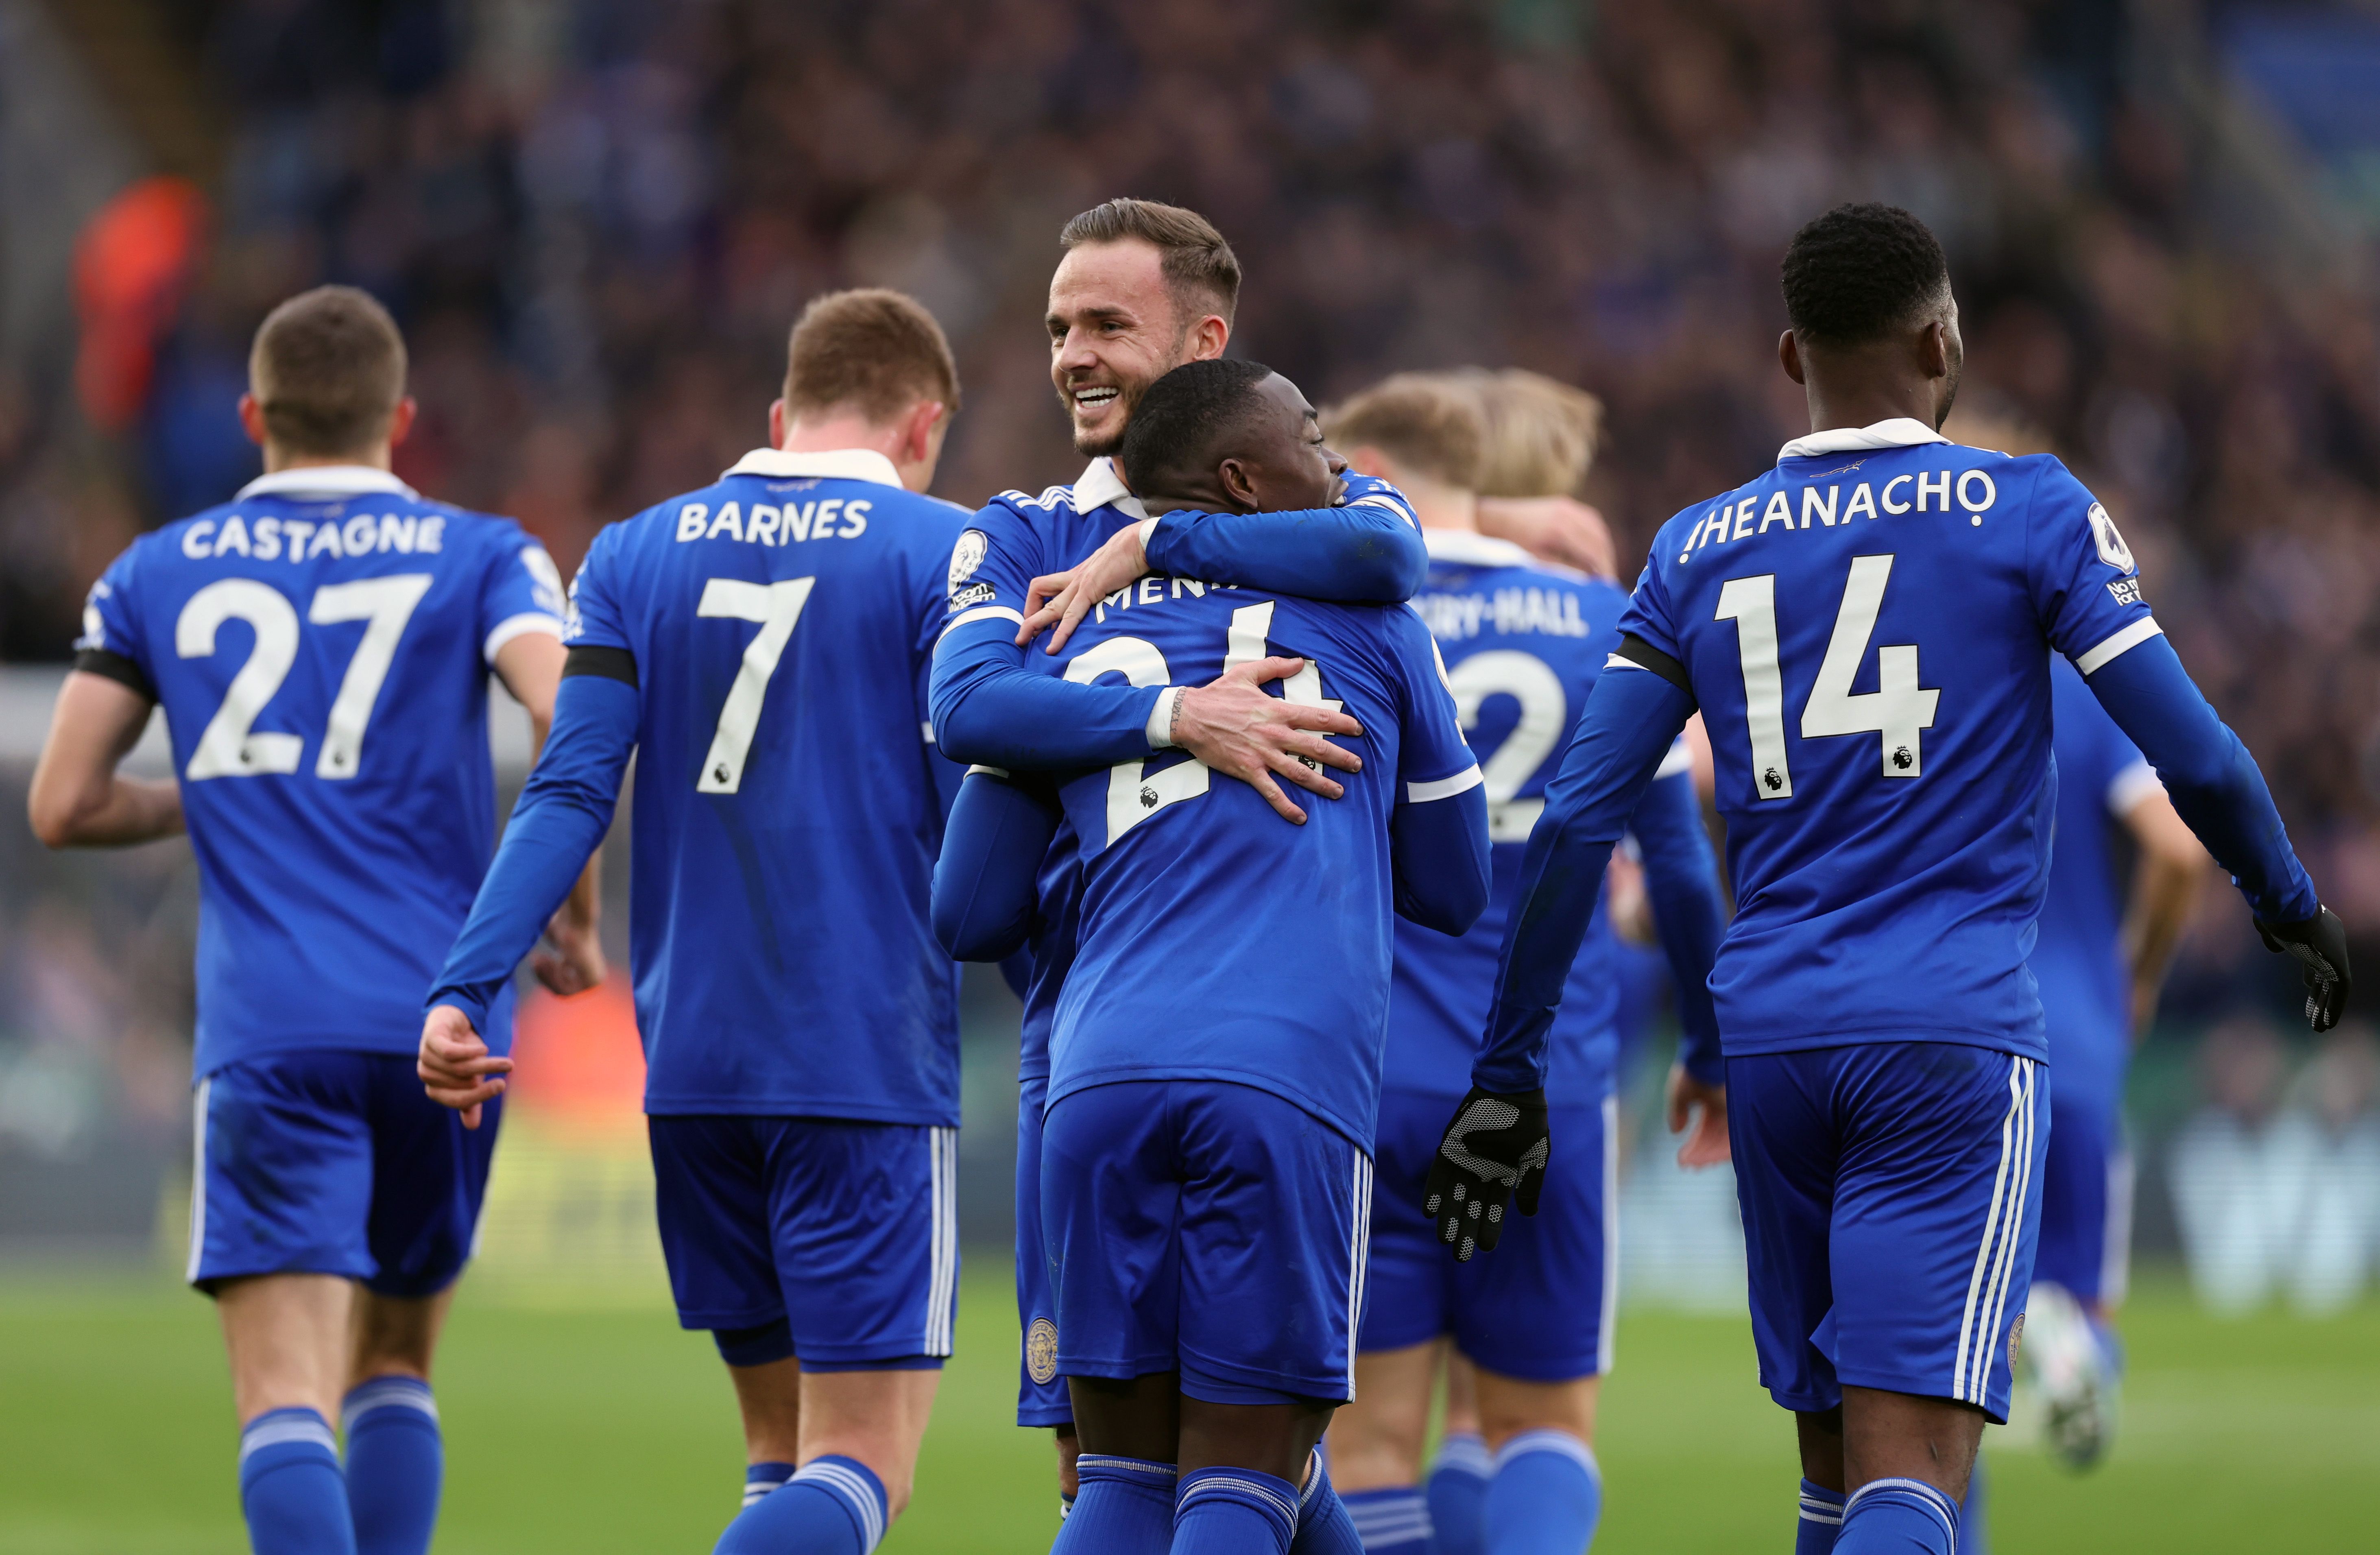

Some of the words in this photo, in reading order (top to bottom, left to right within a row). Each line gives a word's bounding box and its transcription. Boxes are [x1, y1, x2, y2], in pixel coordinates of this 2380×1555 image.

[182, 513, 447, 564] CASTAGNE
[676, 499, 873, 547] BARNES
[953, 583, 988, 607] room
[1095, 575, 1239, 625] MEN
[2106, 582, 2129, 596] No
[2114, 592, 2136, 606] for
[175, 573, 434, 782] 27
[696, 575, 816, 794] 7
[1713, 553, 1941, 800] 14
